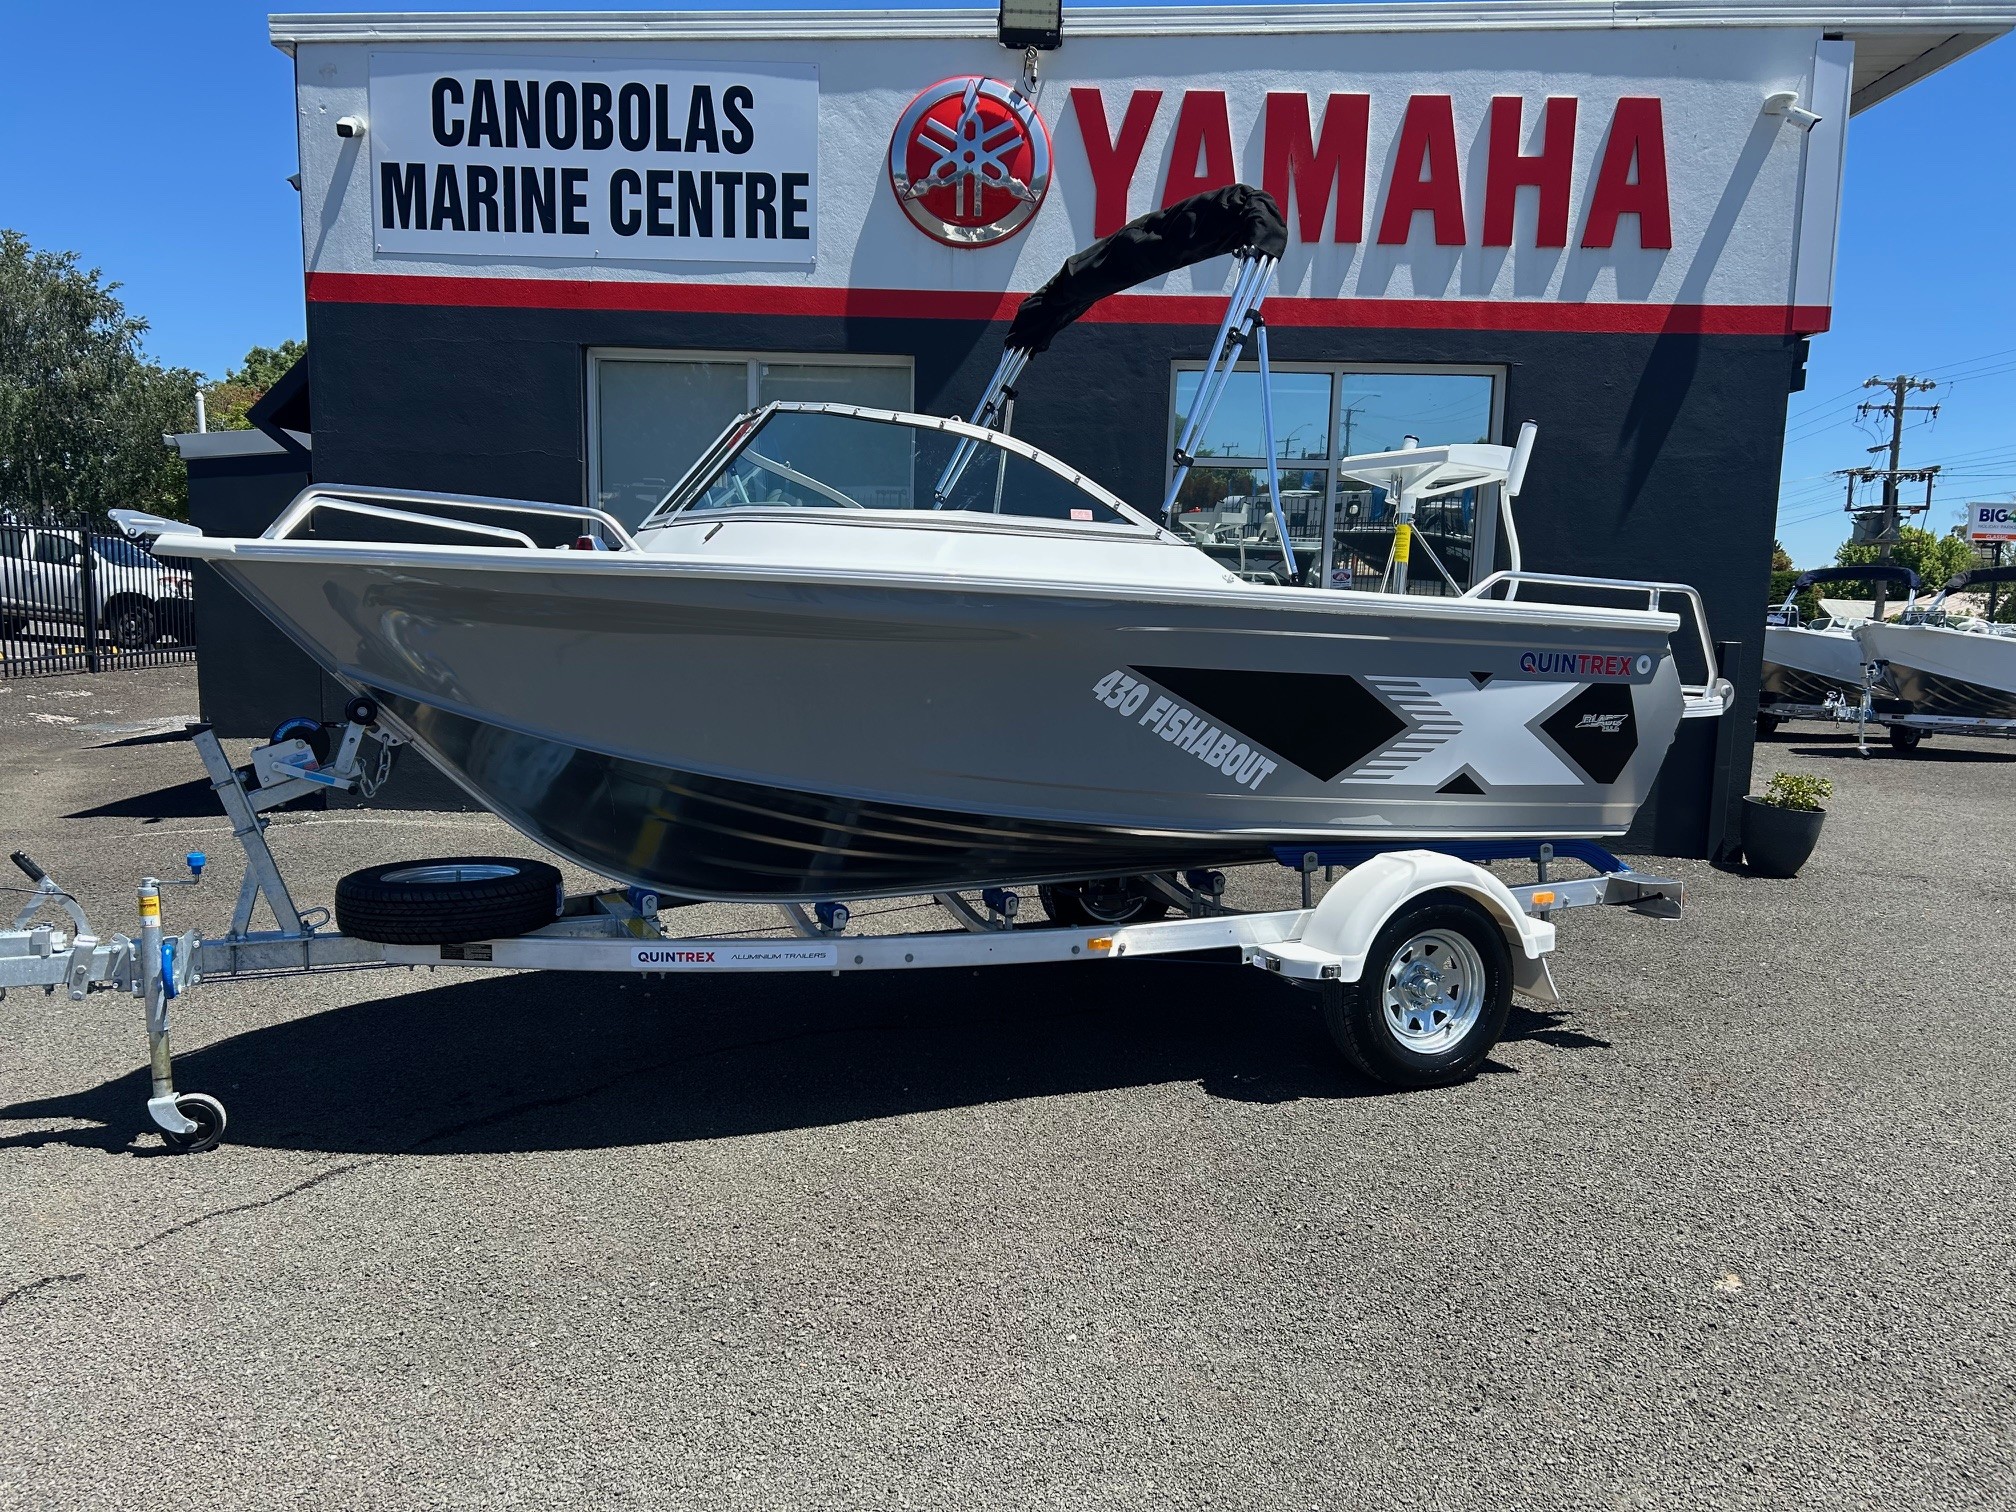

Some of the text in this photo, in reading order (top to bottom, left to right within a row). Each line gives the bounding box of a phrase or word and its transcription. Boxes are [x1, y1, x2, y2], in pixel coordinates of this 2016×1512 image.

[431, 77, 754, 155] CANOBOLAS
[380, 162, 810, 240] MARINE CENTRE
[1070, 87, 1672, 249] YAMAHA
[1520, 652, 1632, 676] QUINTREX
[1092, 669, 1278, 790] 430 FISHABOUT
[638, 951, 716, 963] QUINTREX
